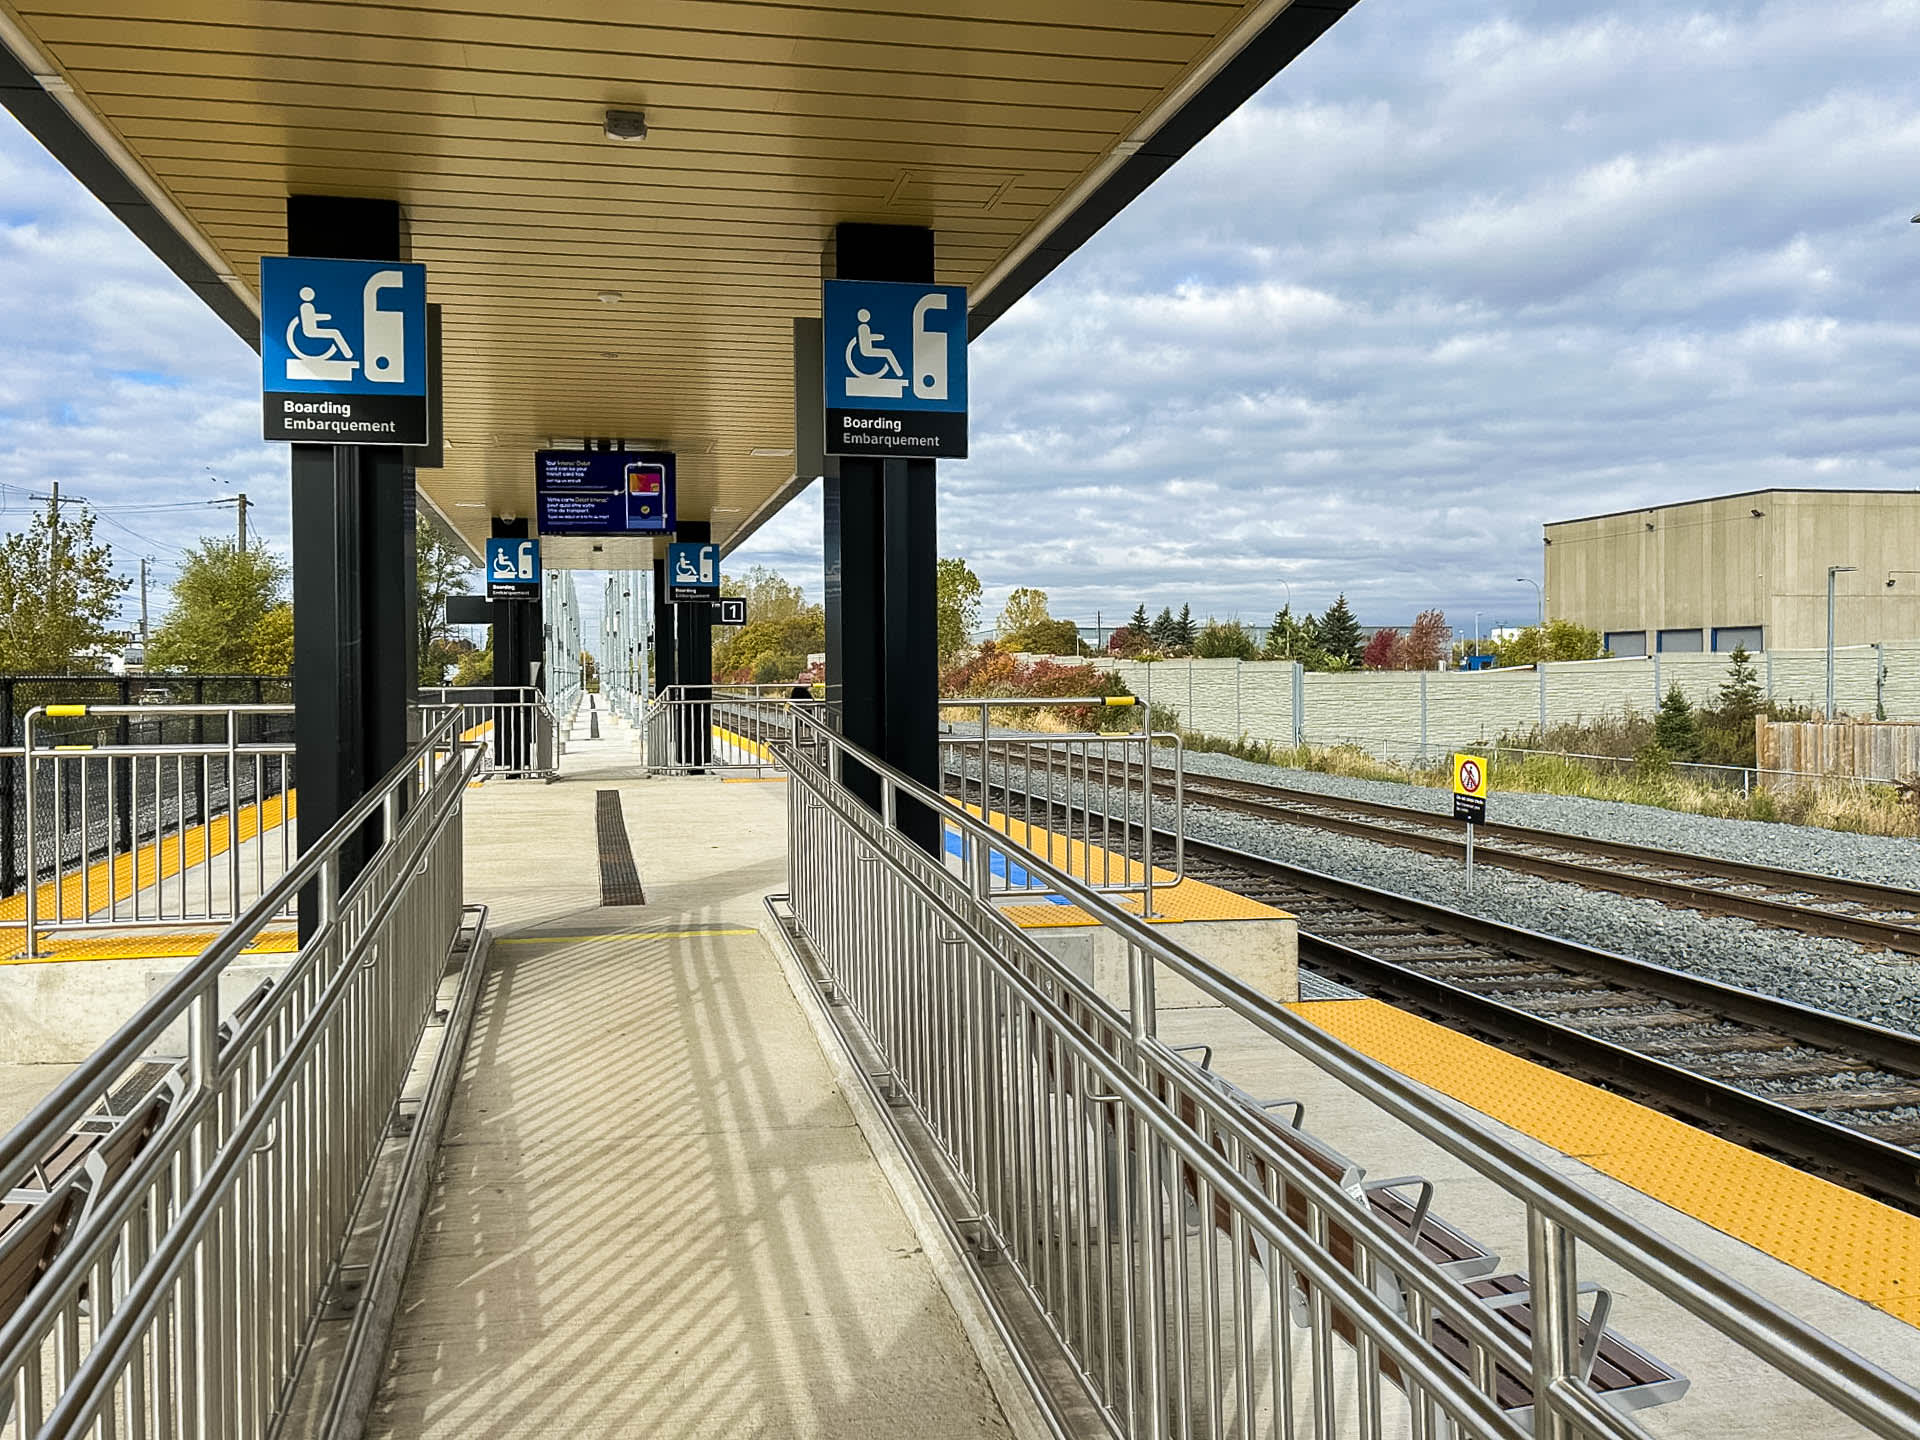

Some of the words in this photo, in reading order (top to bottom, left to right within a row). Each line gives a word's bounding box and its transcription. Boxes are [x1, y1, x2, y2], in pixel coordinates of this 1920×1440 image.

[283, 400, 351, 418] Boarding
[283, 417, 396, 434] Embarquement
[843, 416, 902, 432] Boarding
[843, 432, 940, 448] Embarquement
[729, 604, 737, 618] 1
